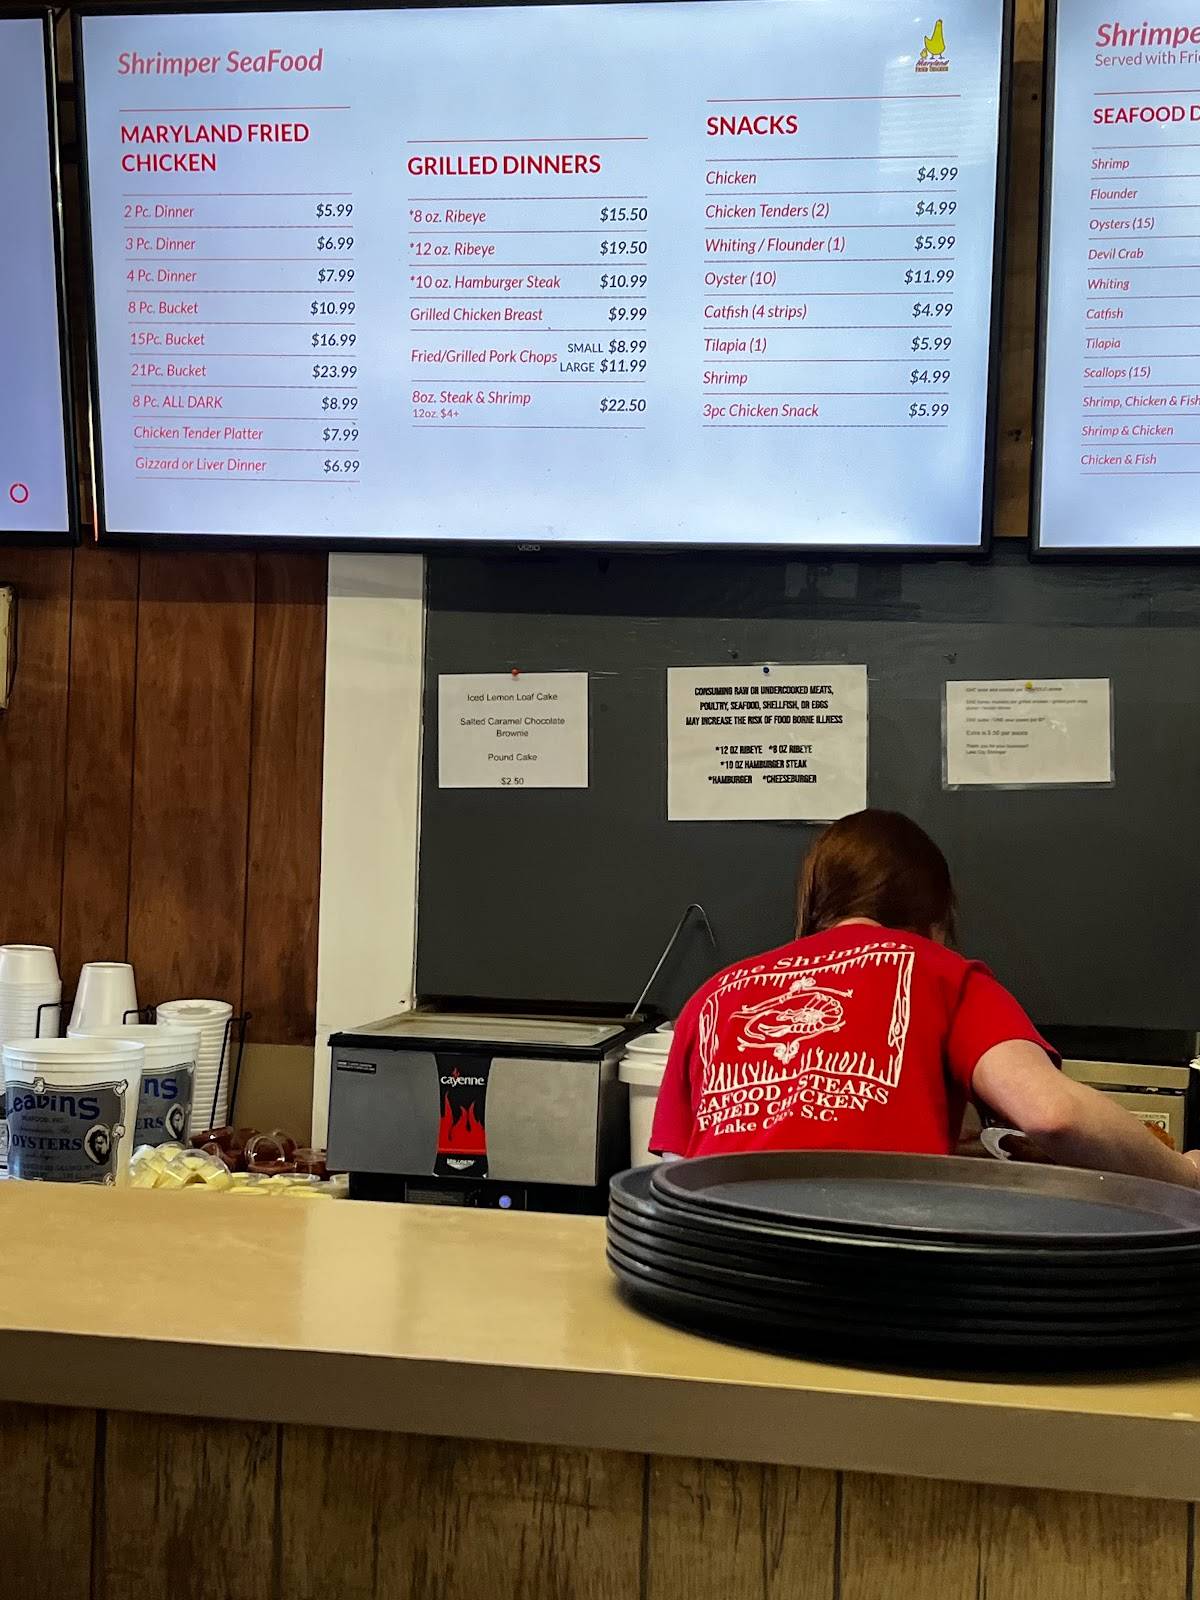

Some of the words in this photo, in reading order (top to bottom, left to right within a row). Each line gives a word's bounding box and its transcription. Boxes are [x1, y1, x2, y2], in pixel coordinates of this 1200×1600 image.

[118, 52, 220, 76] Shrimper
[226, 48, 324, 72] SeaFood
[1095, 53, 1142, 67] Served
[1146, 51, 1176, 64] with
[1093, 106, 1185, 124] SEAFOOD
[707, 115, 798, 135] SNACKS
[121, 124, 242, 144] MARYLAND
[248, 124, 310, 142] FRIED
[122, 154, 216, 172] CHICKEN
[408, 156, 498, 176] GRILLED
[503, 155, 601, 174] DINNERS
[1091, 159, 1129, 171] Shrimp
[706, 171, 756, 185] Chicken
[917, 167, 958, 182] $4.99
[1091, 189, 1138, 200] Flounder
[124, 206, 132, 218] 2
[135, 205, 151, 218] Pc.
[155, 205, 195, 218] Dinner
[316, 203, 353, 218] $5.99
[425, 212, 442, 223] oz.
[445, 210, 486, 225] Ribeye
[600, 207, 647, 222] $15.50
[1090, 219, 1130, 231] Oysters
[1132, 217, 1154, 230] (15)
[705, 239, 756, 254] Whiting
[758, 239, 764, 252] /
[767, 238, 825, 251] Flounder
[828, 237, 845, 252] (1)
[915, 235, 955, 250] $5.99
[1088, 249, 1115, 260] Devil
[1118, 248, 1144, 260] Crab
[435, 278, 451, 288] oz.
[455, 276, 523, 291] Hamburger
[527, 275, 561, 288] Steak
[600, 274, 647, 289] $10.99
[704, 272, 747, 287] Oyster
[750, 271, 777, 287] (10)
[904, 269, 954, 285] $11.99
[1088, 279, 1130, 290] Whiting
[410, 308, 450, 321] Grilled
[453, 308, 501, 321] Chicken
[504, 308, 543, 321] Breast
[608, 307, 647, 323] $9.99
[704, 305, 748, 319] Catfish
[752, 305, 764, 320] (4
[768, 304, 807, 320] strips)
[912, 303, 953, 318] $4.99
[1086, 308, 1123, 320] Catfish
[130, 333, 162, 344] 15Pc.
[165, 333, 205, 346] Bucket
[311, 333, 356, 347] $16.99
[567, 344, 603, 353] SMALL
[608, 340, 647, 355] $8.99
[1086, 338, 1121, 350] Tilapia
[411, 349, 486, 363] Fried/Grilled
[490, 350, 516, 363] Pork
[520, 350, 558, 365] Chops
[560, 362, 595, 372] LARGE
[600, 359, 647, 374] $11.99
[1084, 367, 1126, 379] Scallops
[1129, 366, 1151, 379] (15)
[132, 396, 140, 407] 8
[143, 396, 159, 407] Pc.
[162, 396, 184, 408] ALL
[188, 396, 223, 409] DARK
[321, 397, 358, 411] $8.99
[412, 391, 437, 404] 8oz.
[440, 391, 472, 404] Steak
[476, 392, 485, 404] &
[488, 391, 531, 407] Shrimp
[600, 398, 646, 413] $22.50
[1083, 397, 1122, 409] Shrimp,
[1125, 396, 1167, 407] Chicken
[1169, 396, 1177, 406] &
[1180, 395, 1200, 406] Fish
[134, 426, 179, 439] Chicken
[183, 427, 221, 439] Tender
[224, 427, 263, 440] Platter
[322, 428, 359, 442] $7.99
[135, 457, 179, 470] Gizzard
[182, 460, 194, 470] or
[197, 458, 224, 471] Liver
[227, 458, 267, 472] Dinner
[323, 459, 360, 474] $6.99
[1081, 455, 1122, 465] Chicken
[1124, 455, 1133, 465] &
[1135, 454, 1156, 465] Fish
[517, 693, 534, 701] Loaf
[537, 693, 558, 701] Cake
[734, 687, 749, 695] RAW
[761, 686, 808, 694] UNDERCOOKED
[810, 686, 834, 695] MEATS,
[700, 702, 729, 711] POULTRY,
[731, 701, 761, 710] SEAFOOD,
[763, 701, 799, 710] SHELLFISH,
[801, 701, 810, 709] OR
[525, 717, 565, 725] Chocolate
[686, 717, 699, 725] MAY
[702, 717, 732, 725] INCREASE
[734, 716, 746, 724] THE
[748, 716, 762, 724] RISK
[764, 716, 772, 724] OF
[730, 746, 738, 754] OZ
[740, 746, 762, 754] RIBEYE
[779, 745, 788, 753] OZ
[789, 745, 812, 753] RIBEYE
[745, 760, 784, 768] HAMBURGER
[786, 760, 807, 768] STEAK
[718, 964, 766, 986] The
[773, 942, 914, 970] Shrimper
[440, 1076, 485, 1087] cayenne
[797, 1073, 889, 1105] STEAKS
[697, 1102, 760, 1132] FRIED
[766, 1089, 869, 1115] CHICKEN
[714, 1119, 757, 1136] Lake
[801, 1105, 838, 1122] S.C.
[12, 1134, 82, 1151] OYSTERS
